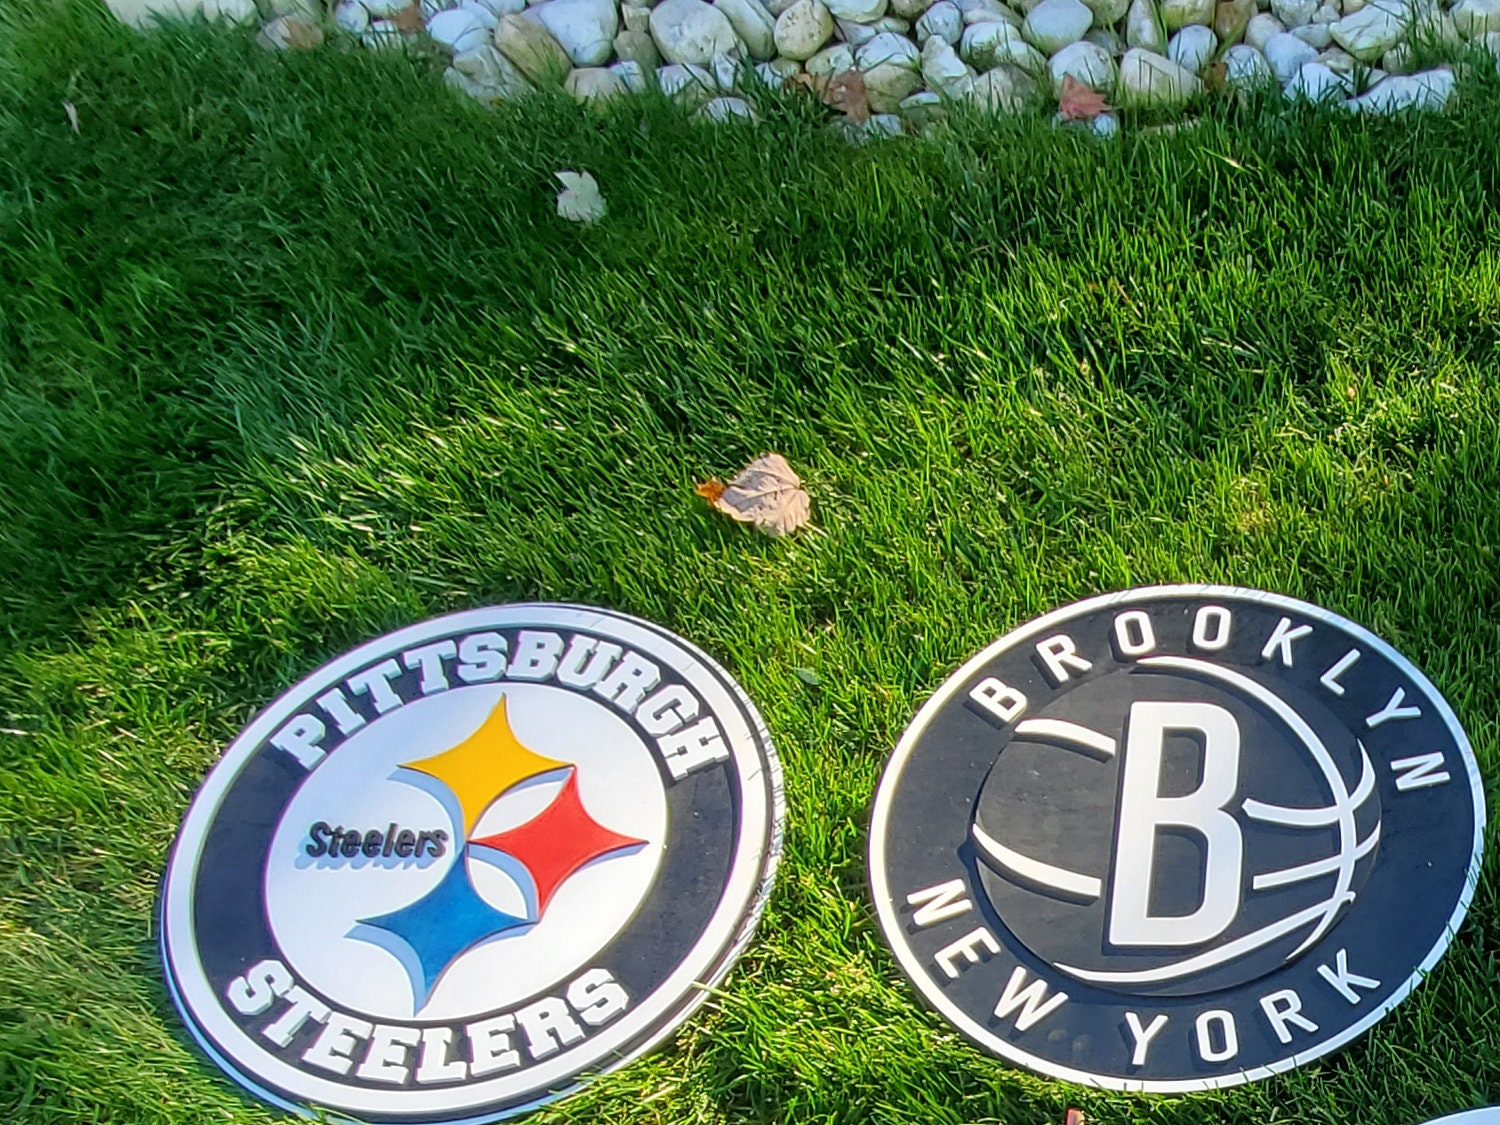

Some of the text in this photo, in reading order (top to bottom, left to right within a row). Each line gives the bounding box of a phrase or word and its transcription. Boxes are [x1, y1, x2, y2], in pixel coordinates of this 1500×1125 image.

[270, 630, 731, 782] PITTSBURGH
[969, 605, 1452, 792] BROOKLYN
[305, 821, 450, 861] Steelers
[1108, 701, 1243, 946] B
[227, 959, 630, 1085] STEELERS
[906, 878, 1381, 1066] NEW YORK
